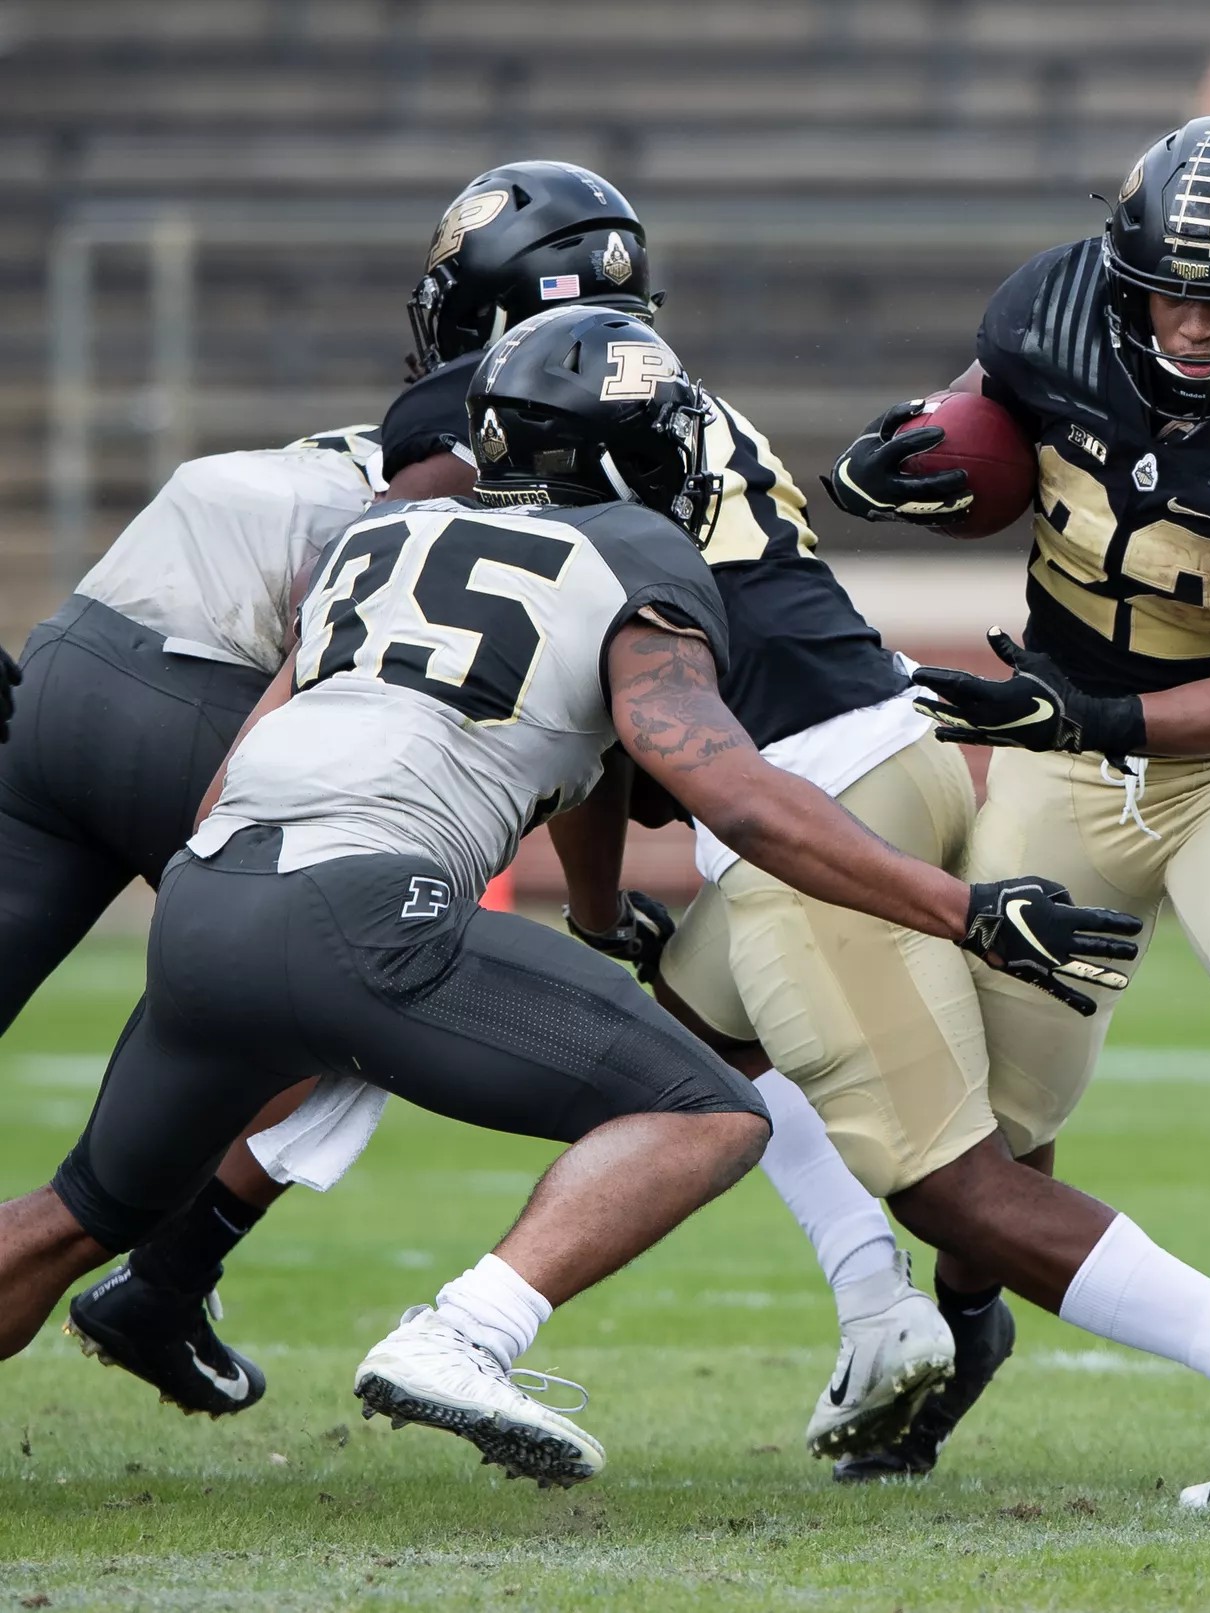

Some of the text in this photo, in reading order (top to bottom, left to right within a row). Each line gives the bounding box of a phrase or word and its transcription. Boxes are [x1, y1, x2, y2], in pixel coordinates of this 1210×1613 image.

[428, 189, 509, 273] P
[1171, 260, 1210, 280] PURDUE
[599, 341, 678, 401] P
[401, 876, 451, 918] P
